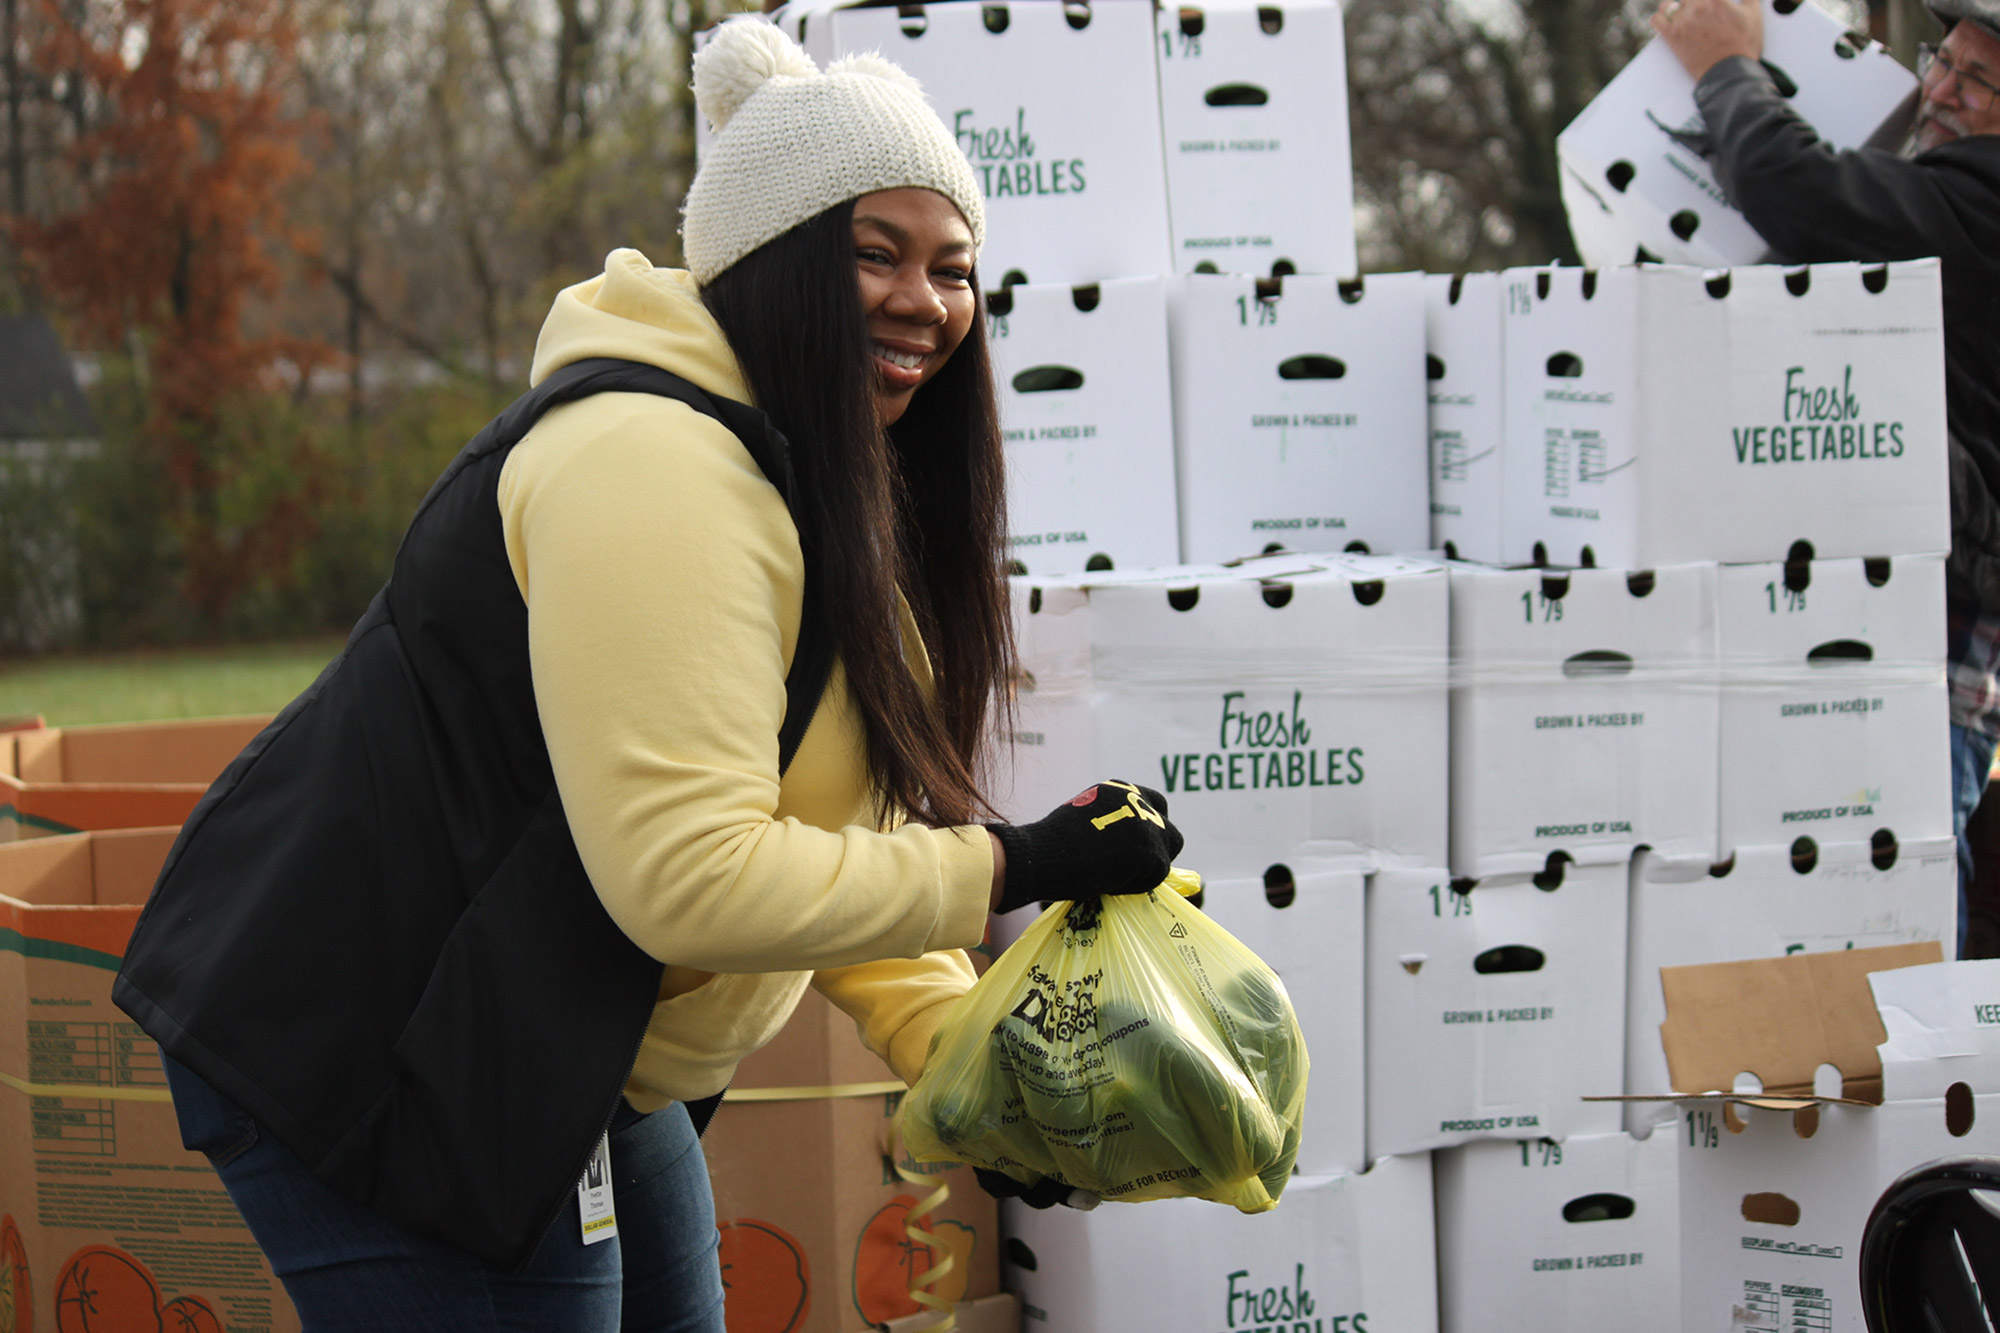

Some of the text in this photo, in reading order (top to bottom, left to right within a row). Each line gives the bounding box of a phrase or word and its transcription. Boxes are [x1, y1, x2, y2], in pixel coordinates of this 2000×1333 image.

[954, 106, 1036, 160] Fresh
[975, 158, 1086, 198] TABLES
[1784, 364, 1860, 423] Fresh
[1733, 422, 1905, 464] VEGETABLES
[1252, 517, 1346, 530] PRODUCE OF USA
[1046, 532, 1062, 544] OF
[1064, 531, 1088, 543] USA
[1220, 688, 1311, 749] Fresh
[1160, 746, 1365, 793] VEGETABLES
[1782, 804, 1874, 822] PRODUCE OF USA
[1536, 821, 1632, 838] PRODUCE OF USA
[1444, 1010, 1483, 1024] GROWN
[1498, 1007, 1537, 1022] PACKED
[1541, 1006, 1554, 1020] BY
[1030, 1062, 1044, 1076] up
[1046, 1067, 1066, 1080] and
[1068, 1068, 1083, 1079] ave
[1082, 1056, 1106, 1072] oday!
[1440, 1115, 1540, 1132] PRODUCE OF USA
[1106, 1181, 1136, 1197] STORE
[1136, 1174, 1157, 1190] FOR
[1534, 1258, 1573, 1272] GROWN
[1587, 1254, 1627, 1268] PACKED
[1630, 1252, 1644, 1266] BY
[1226, 1262, 1315, 1328] Fresh
